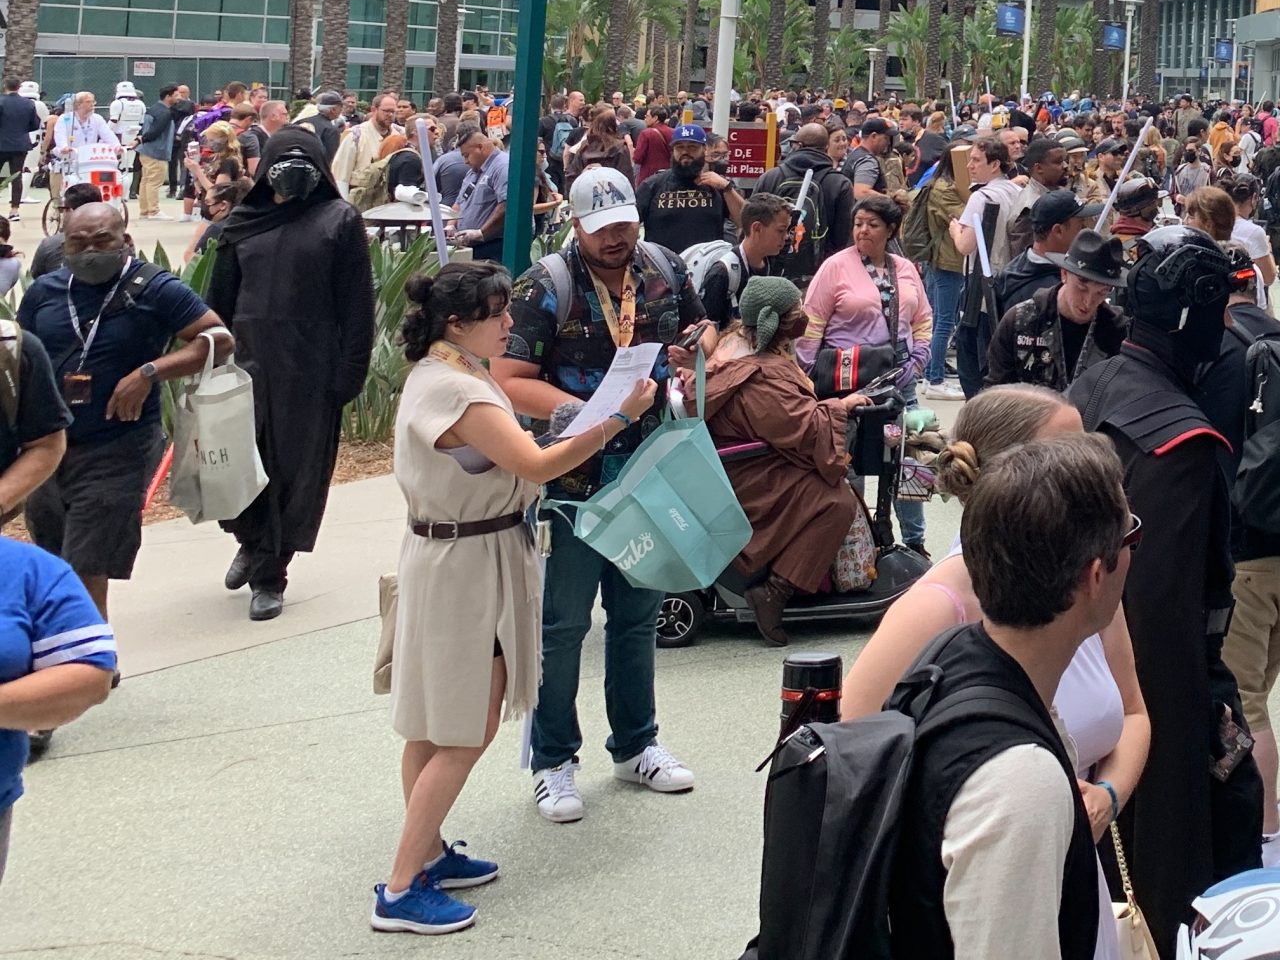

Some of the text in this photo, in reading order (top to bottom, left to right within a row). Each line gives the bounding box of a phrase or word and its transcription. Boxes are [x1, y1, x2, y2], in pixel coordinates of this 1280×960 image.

[730, 132, 738, 141] C
[740, 164, 765, 174] Plaza
[658, 199, 713, 209] KENOBI
